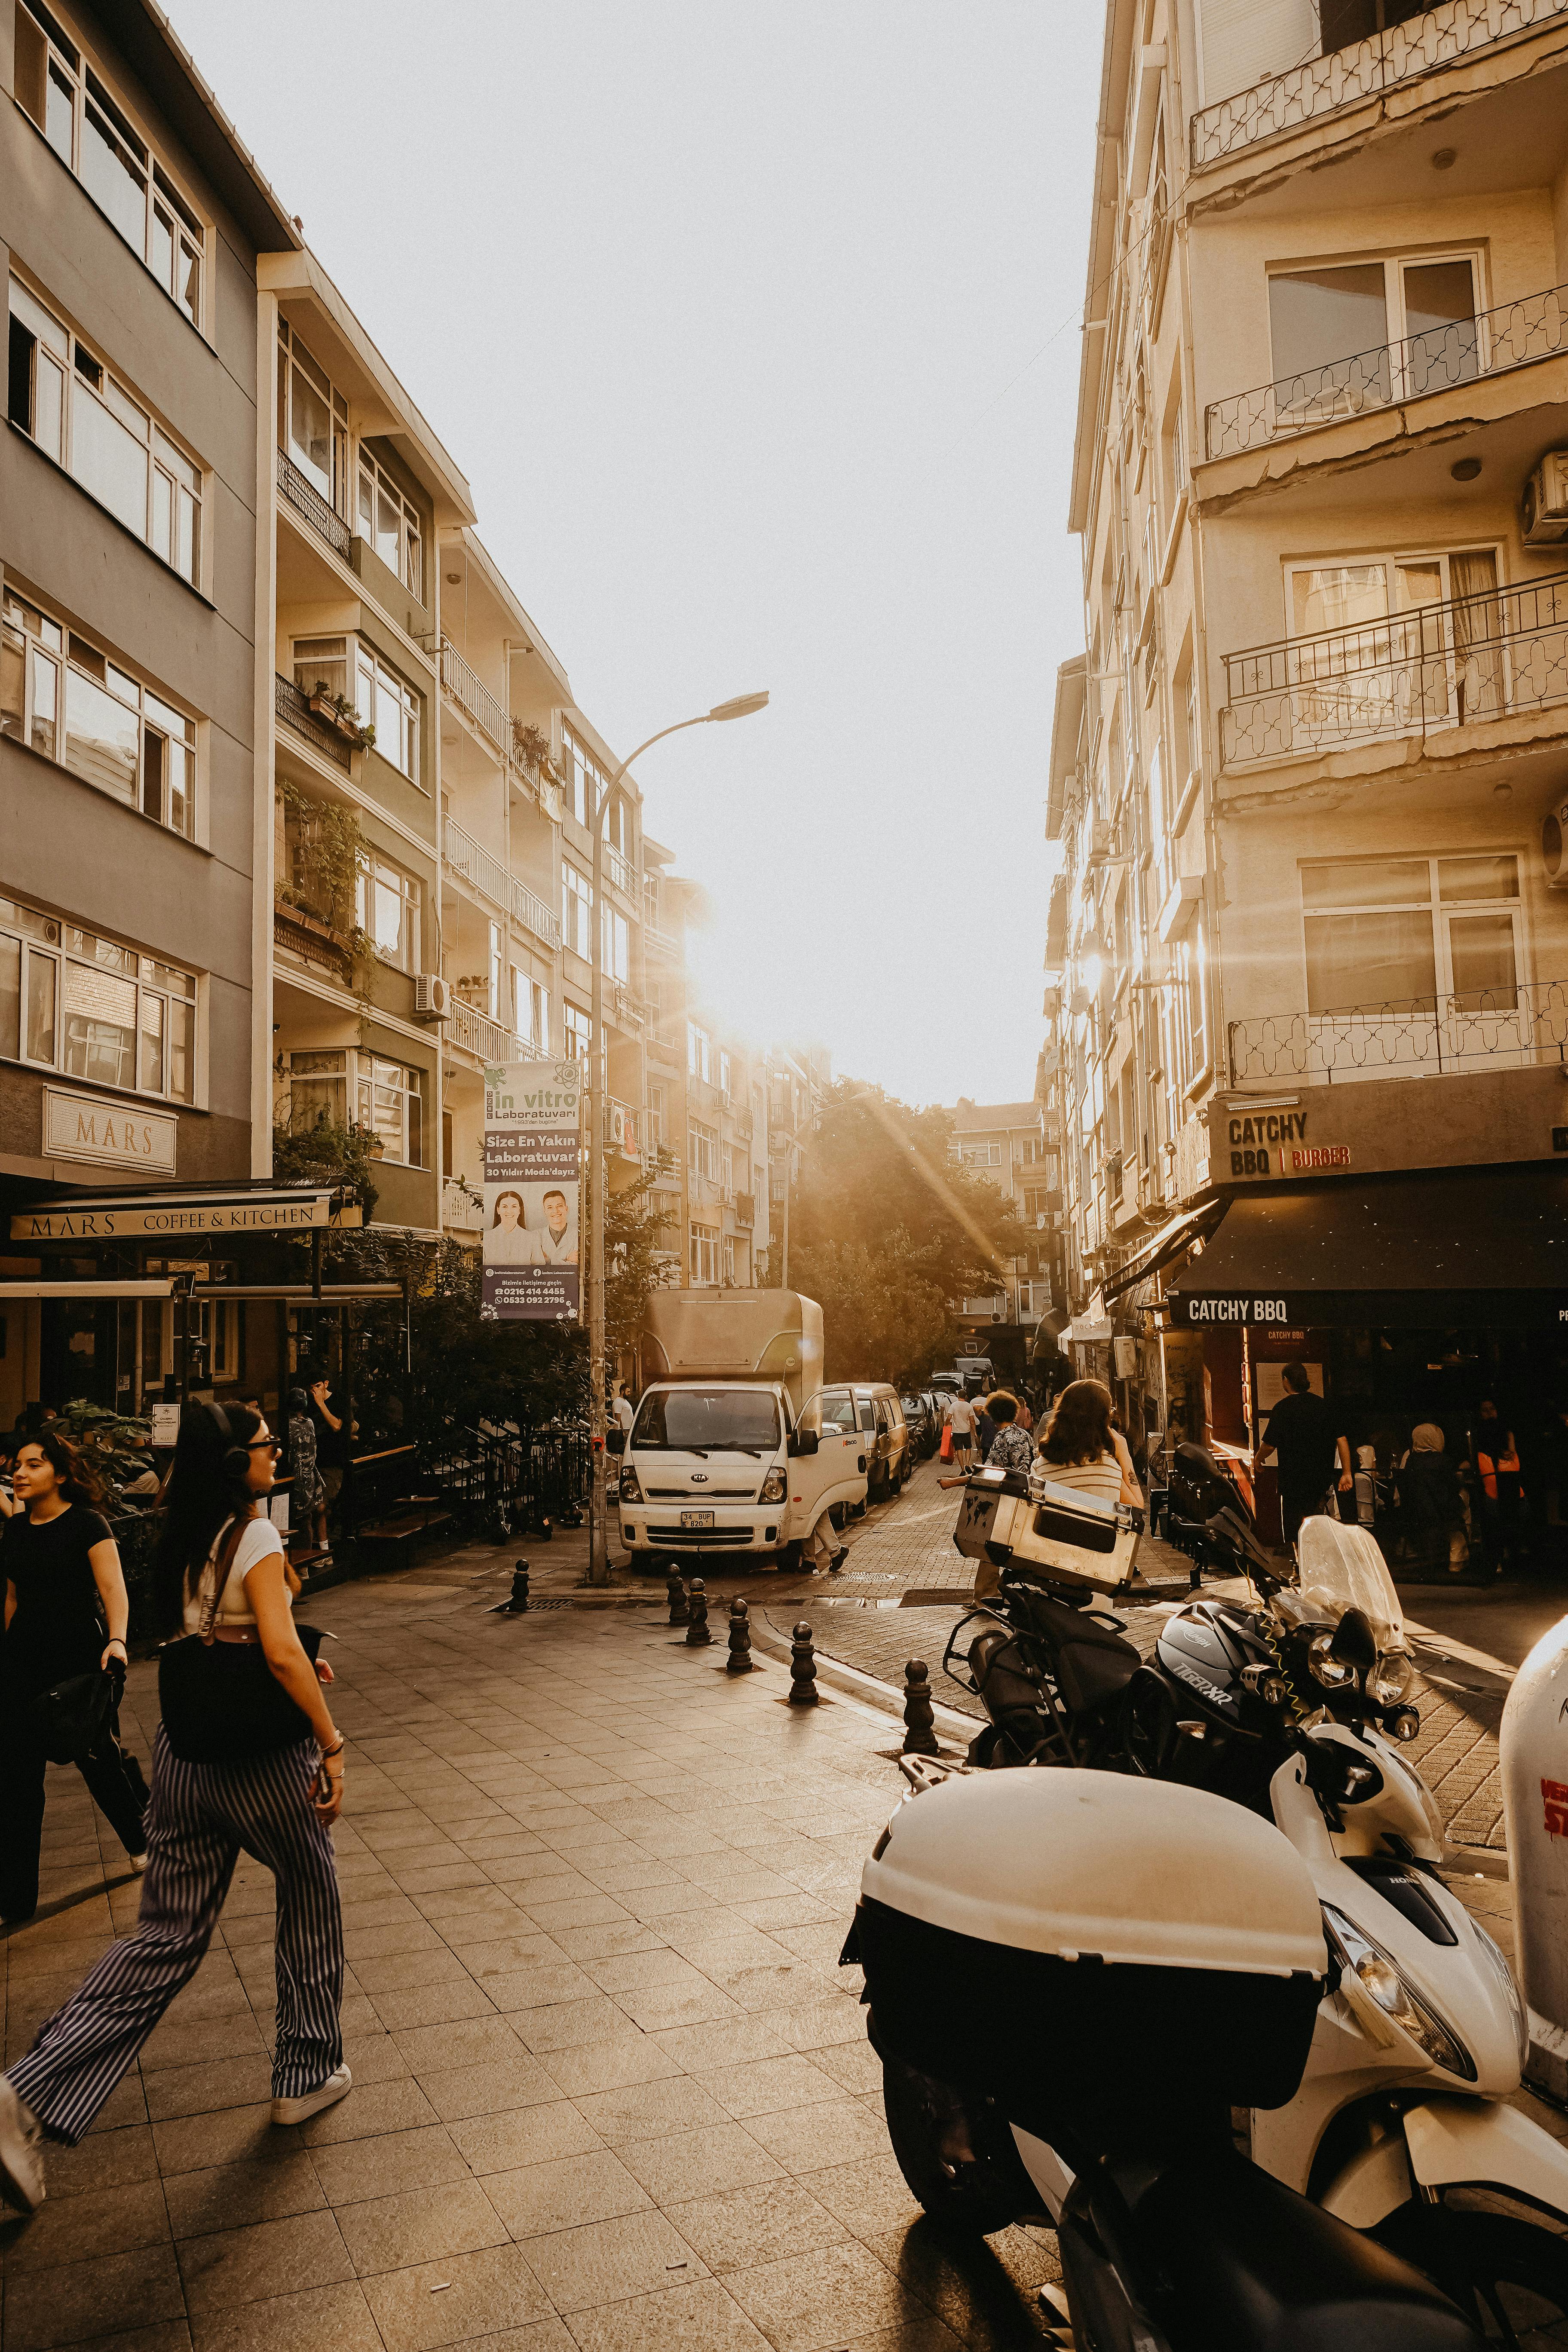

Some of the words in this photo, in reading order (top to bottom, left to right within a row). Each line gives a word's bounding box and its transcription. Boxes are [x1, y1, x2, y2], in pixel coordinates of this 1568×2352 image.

[495, 1091, 514, 1109] in
[524, 1090, 576, 1108] vitro
[495, 1110, 575, 1119] Laboratuvarı
[76, 1112, 152, 1154] MARS
[1229, 1112, 1307, 1144] CATCHY
[486, 1135, 515, 1147] Size
[518, 1136, 536, 1147] En
[537, 1134, 576, 1146] Yakın
[486, 1151, 575, 1163] Laboratuvar
[1231, 1148, 1270, 1176] BBQ
[1292, 1146, 1351, 1168] BURGER
[500, 1168, 524, 1176] Yıldır
[31, 1213, 115, 1236] MARS
[144, 1213, 205, 1230] COFFEE
[211, 1212, 225, 1227] &
[230, 1207, 314, 1225] KITCHEN
[1189, 1300, 1249, 1320] CATCHY
[1254, 1300, 1287, 1323] BBQ
